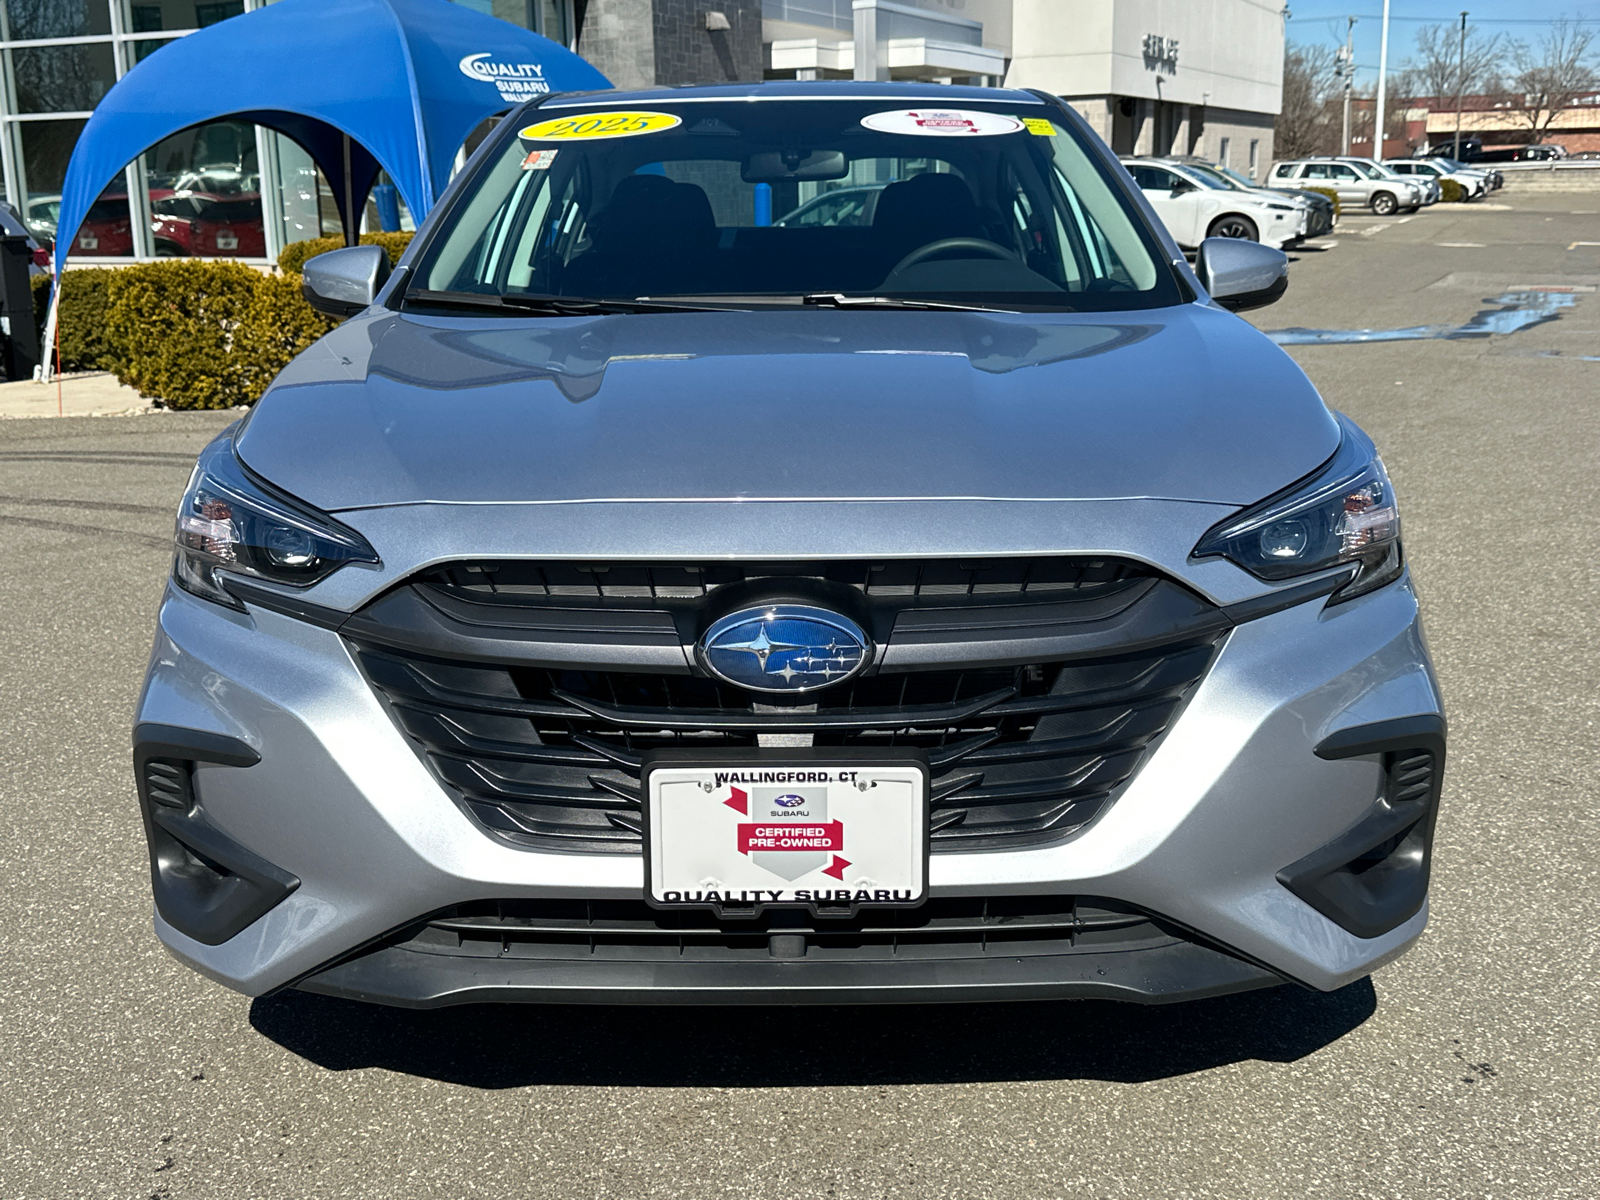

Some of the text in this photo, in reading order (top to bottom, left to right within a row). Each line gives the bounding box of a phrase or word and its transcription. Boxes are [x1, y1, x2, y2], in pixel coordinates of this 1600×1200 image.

[473, 61, 542, 77] QUALITY
[495, 80, 550, 93] SUBARU
[543, 116, 656, 137] 2025
[714, 771, 859, 784] WALLINGFORD, CT
[755, 828, 825, 837] CERTIFIED
[749, 838, 832, 847] PRE-OWNED
[663, 889, 912, 902] QUALITY SUBARU
